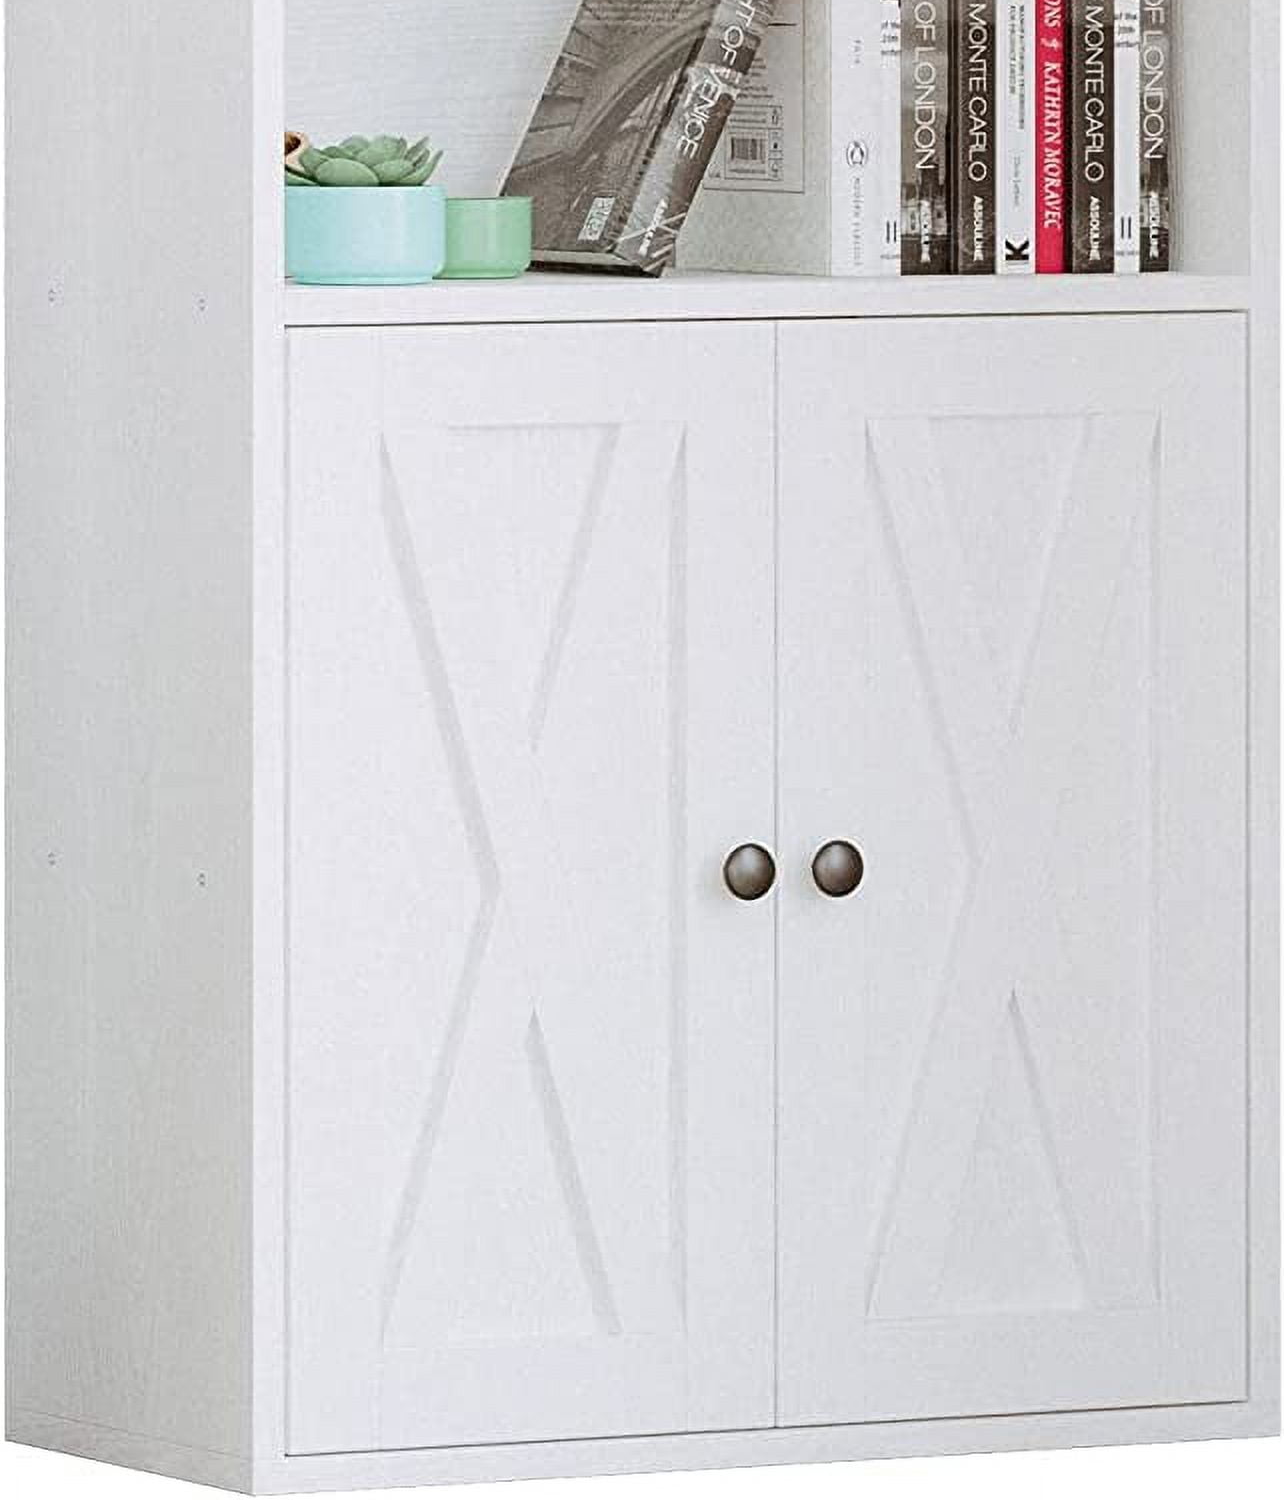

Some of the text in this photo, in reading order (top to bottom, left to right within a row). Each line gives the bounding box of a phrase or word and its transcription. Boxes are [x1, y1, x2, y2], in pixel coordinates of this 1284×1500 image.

[720, 25, 744, 66] OF
[914, 1, 937, 42] OF
[968, 3, 987, 92] MONTE
[1085, 5, 1105, 94] MONTE
[677, 67, 741, 160] VENICE
[914, 46, 936, 170] LONDON
[968, 96, 987, 183] CARLO
[1143, 30, 1165, 160] LONDON
[1044, 61, 1064, 230] KATHRYN MORAVEC
[1085, 98, 1105, 183] CARLO
